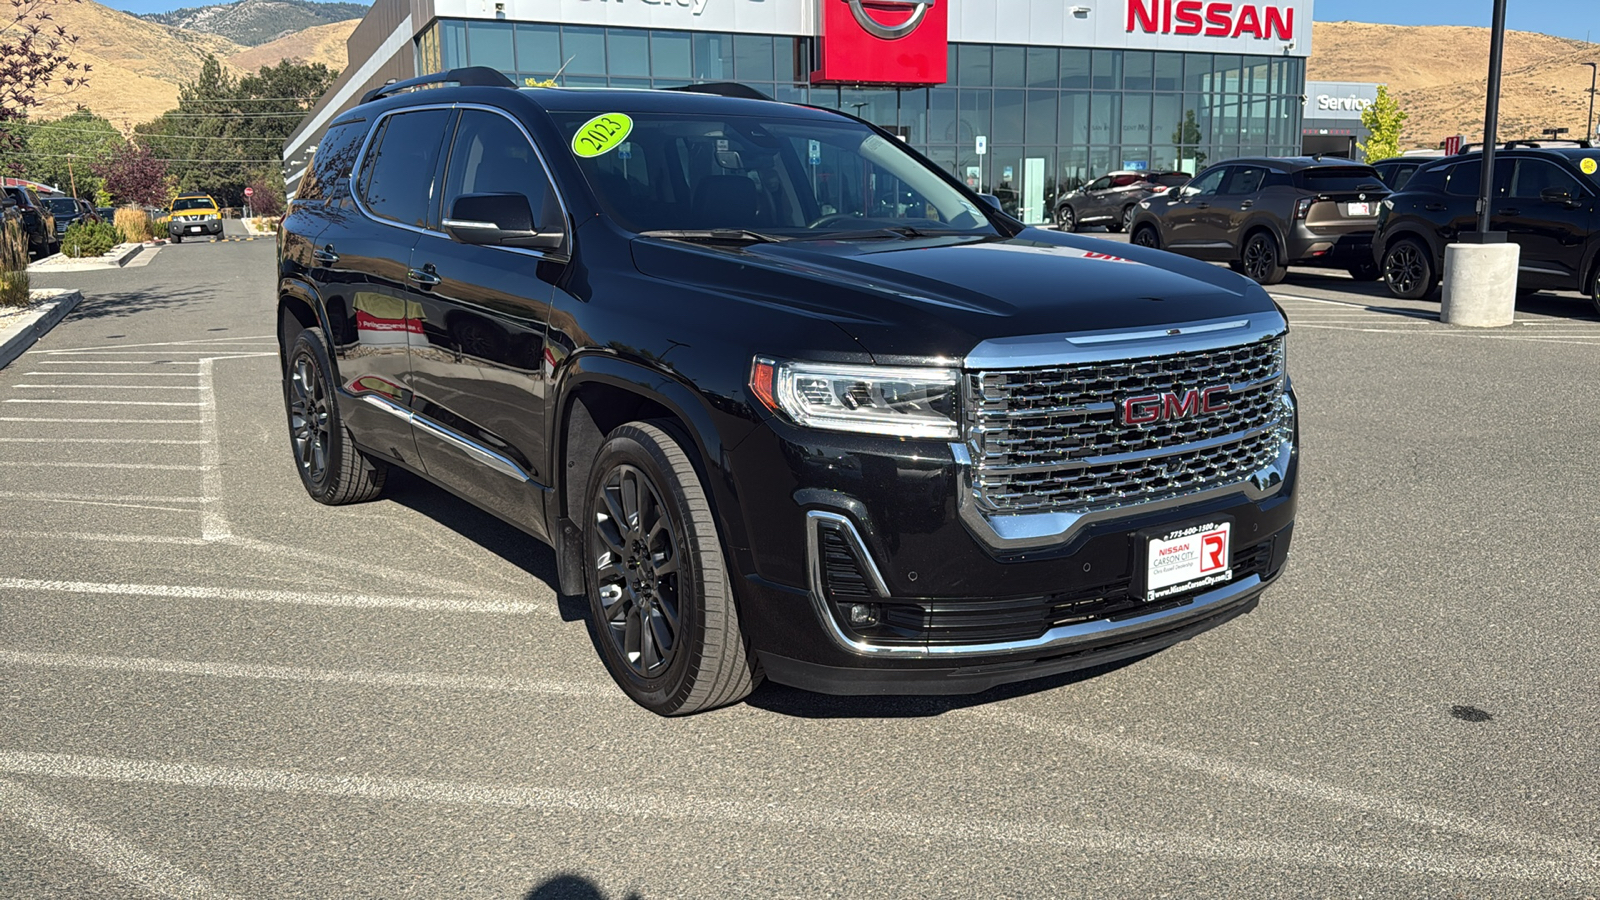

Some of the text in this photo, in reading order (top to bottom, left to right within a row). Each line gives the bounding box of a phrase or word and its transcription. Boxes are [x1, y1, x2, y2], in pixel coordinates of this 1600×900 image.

[1126, 0, 1294, 41] NISSAN
[1318, 94, 1371, 111] Service
[581, 117, 622, 151] 2023
[1122, 384, 1231, 425] GMC
[1169, 522, 1215, 540] 775-600-1500
[1159, 543, 1190, 556] NISSAN
[1153, 551, 1195, 567] CARSON CITY
